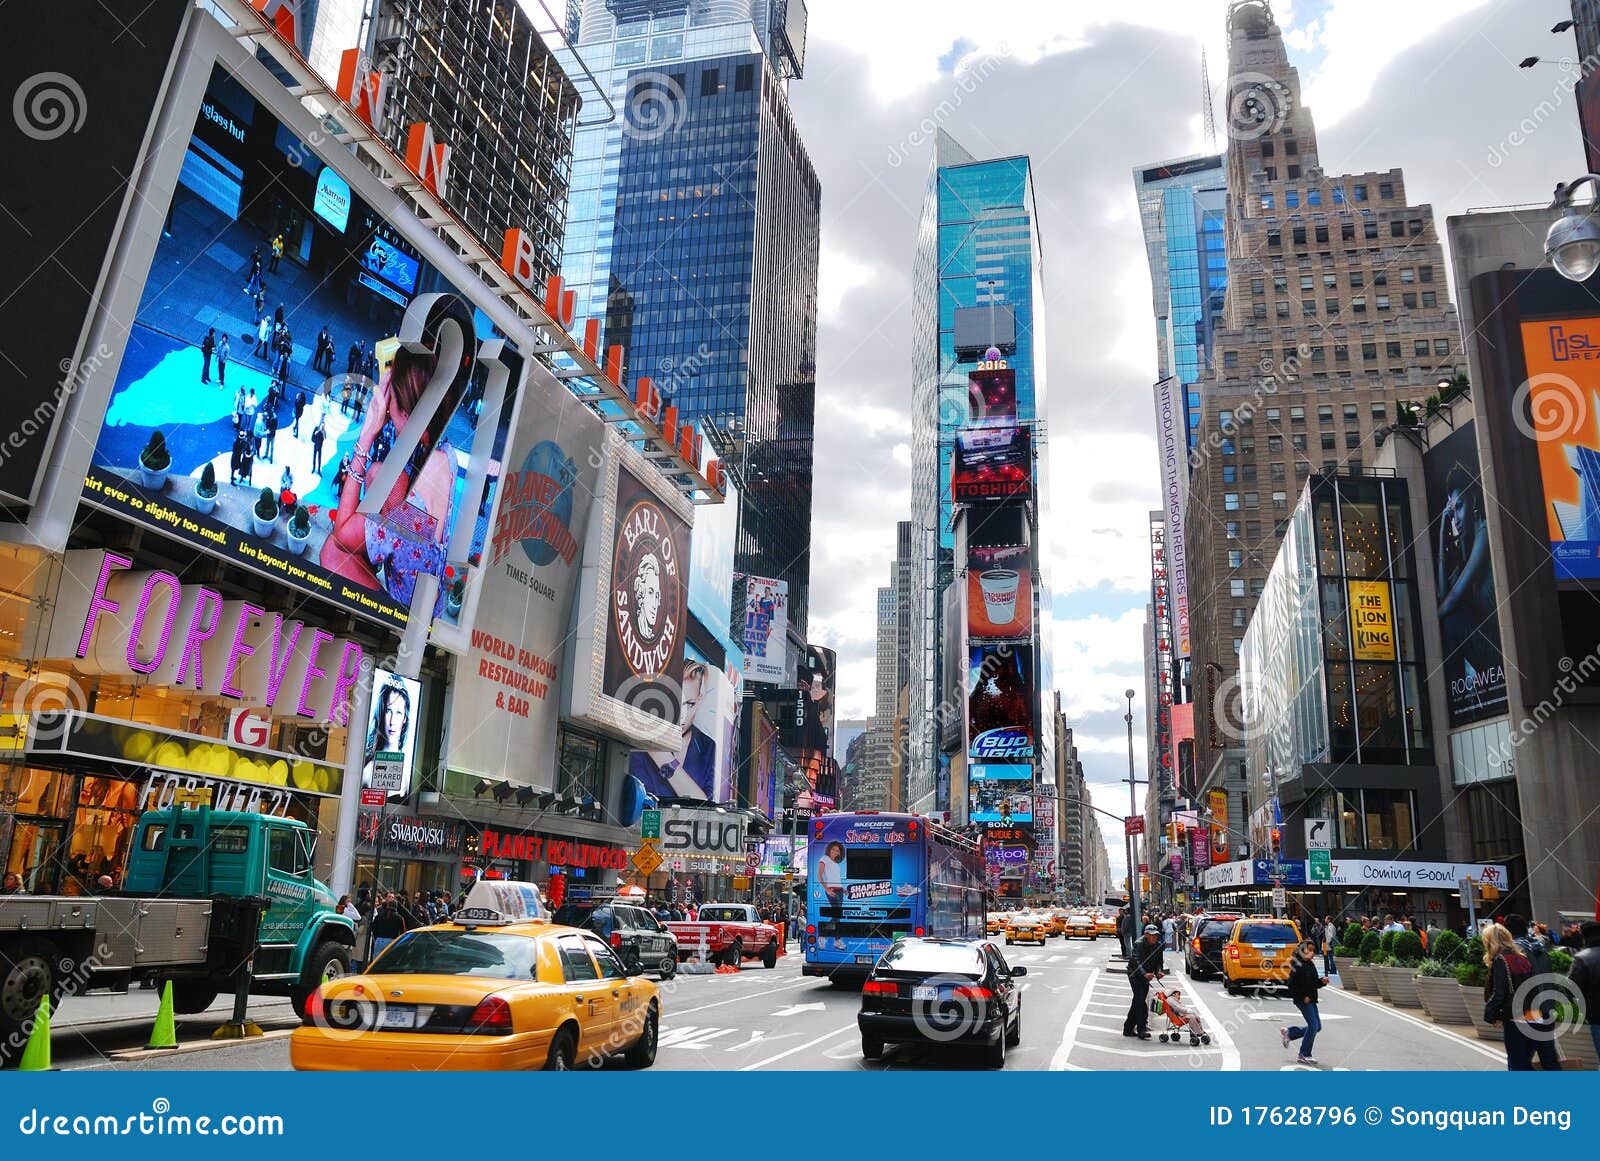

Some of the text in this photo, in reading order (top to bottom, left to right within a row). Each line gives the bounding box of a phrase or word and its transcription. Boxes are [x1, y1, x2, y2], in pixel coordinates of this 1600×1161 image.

[229, 119, 246, 143] hut
[501, 227, 726, 495] BUILDING
[502, 471, 563, 508] PLANET
[958, 483, 1029, 496] TOSHIBA
[76, 292, 525, 727] FOREVER 21
[104, 486, 129, 502] ever
[130, 497, 143, 508] so
[145, 501, 182, 527] slightly
[183, 517, 198, 532] too
[200, 526, 227, 544] small.
[1159, 383, 1189, 637] INTRODUCING THOMSON REUTERS EIKON
[491, 502, 578, 566] HOLLYWOOD
[624, 508, 676, 576] EARL OF
[239, 542, 333, 590] Live beyond your means.
[506, 563, 555, 601] TIMES SQUARE
[341, 586, 361, 602] Don't
[360, 593, 378, 610] leave
[378, 602, 393, 618] your
[1358, 595, 1381, 606] THE
[1355, 609, 1387, 628] LION
[616, 590, 675, 675] SANDWICH
[1357, 630, 1389, 649] KING
[471, 629, 557, 681] WORLD FAMOUS
[478, 658, 548, 697] RESTAURANT
[1451, 666, 1505, 696] ROCAWEA
[495, 691, 529, 718] & BAR
[233, 708, 270, 747] G
[976, 746, 1033, 757] LIGHT
[982, 736, 1028, 747] BUD
[374, 772, 401, 780] SHARED
[377, 780, 396, 788] LANE
[796, 809, 810, 817] MISS
[391, 823, 443, 845] SWAROVSKI
[884, 831, 904, 846] ups
[482, 830, 543, 861] PLANET
[547, 839, 628, 870] HOLLYWOOD
[1364, 864, 1411, 883] Coming
[267, 880, 308, 899] LANDMARK
[850, 882, 890, 893] SHAPE-UP
[851, 888, 892, 899] ANYWHERE!
